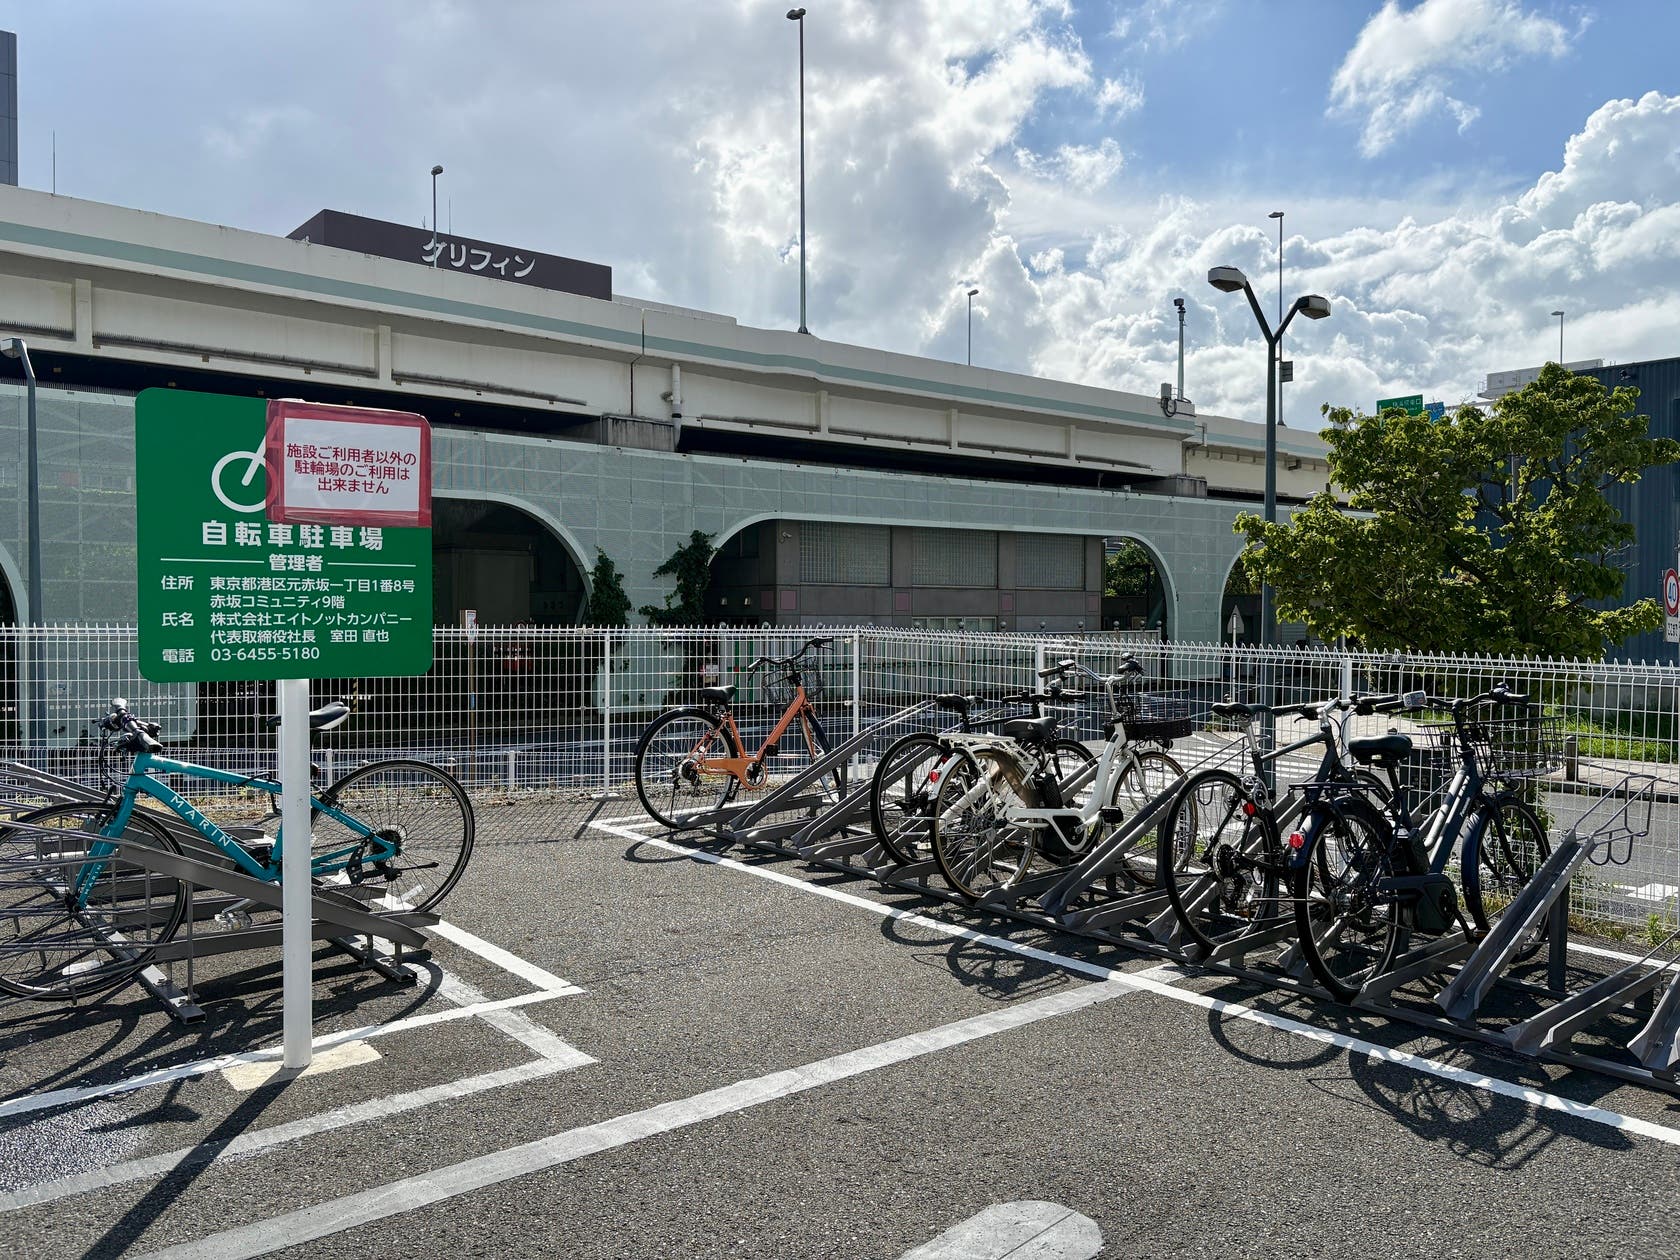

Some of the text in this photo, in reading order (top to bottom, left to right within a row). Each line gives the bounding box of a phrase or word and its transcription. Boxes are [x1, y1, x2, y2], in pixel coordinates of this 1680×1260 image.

[287, 443, 416, 465] 施設ご利用者以外の
[295, 459, 410, 480] 駐輪場のご利用は
[318, 477, 389, 494] 出来ません
[202, 520, 383, 550] 自転車駐車場
[269, 554, 323, 571] 管理者
[161, 576, 415, 592] 住所 東京都港区元赤坂一丁目1番8号
[1668, 582, 1676, 602] 40
[210, 594, 345, 609] 赤坂コミュニティ9階
[161, 611, 412, 627] 氏名 株式会社エイトノットカンパニー
[210, 629, 389, 644] 代表取締役社長 室田 直也
[162, 647, 320, 663] 電話 03-6455-5180
[170, 796, 231, 847] MARIN
